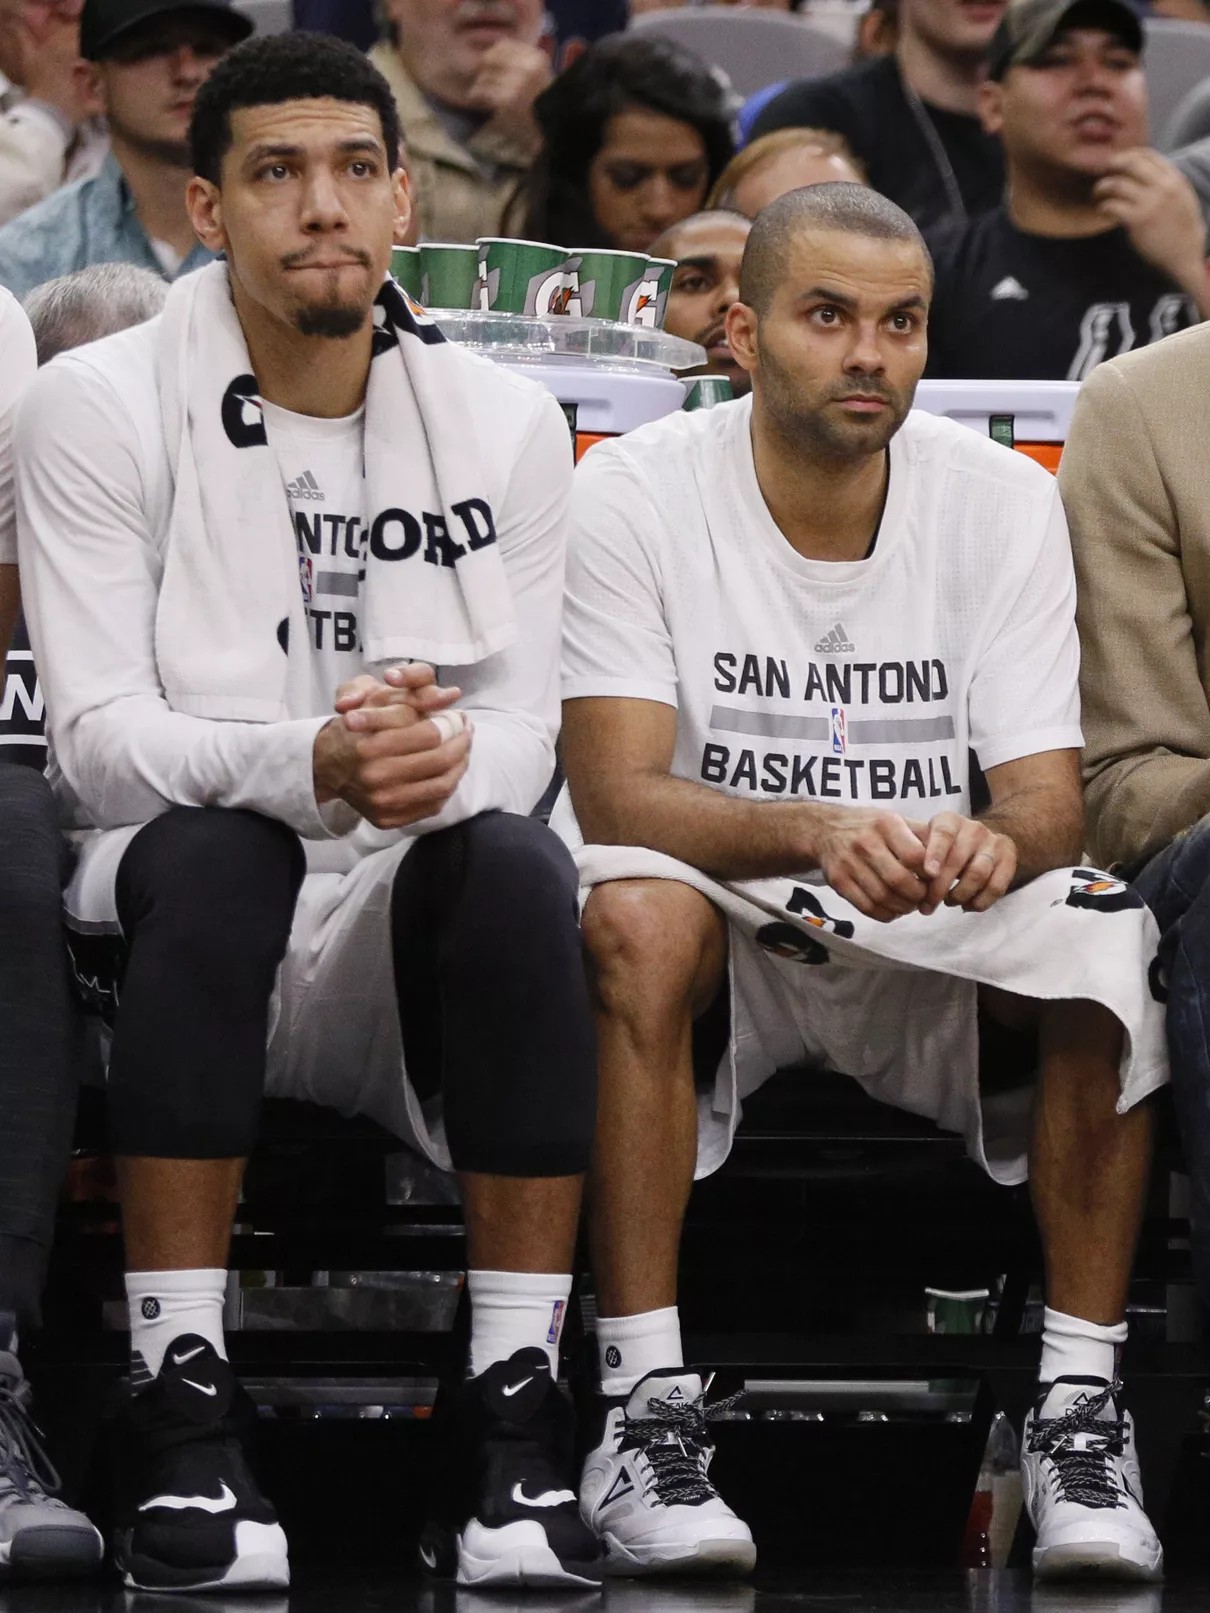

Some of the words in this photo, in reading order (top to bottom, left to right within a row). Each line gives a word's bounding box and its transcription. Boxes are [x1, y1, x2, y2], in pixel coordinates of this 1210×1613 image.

[814, 642, 856, 653] adidas
[714, 652, 790, 699] SAN
[700, 743, 962, 799] BASKETBALL
